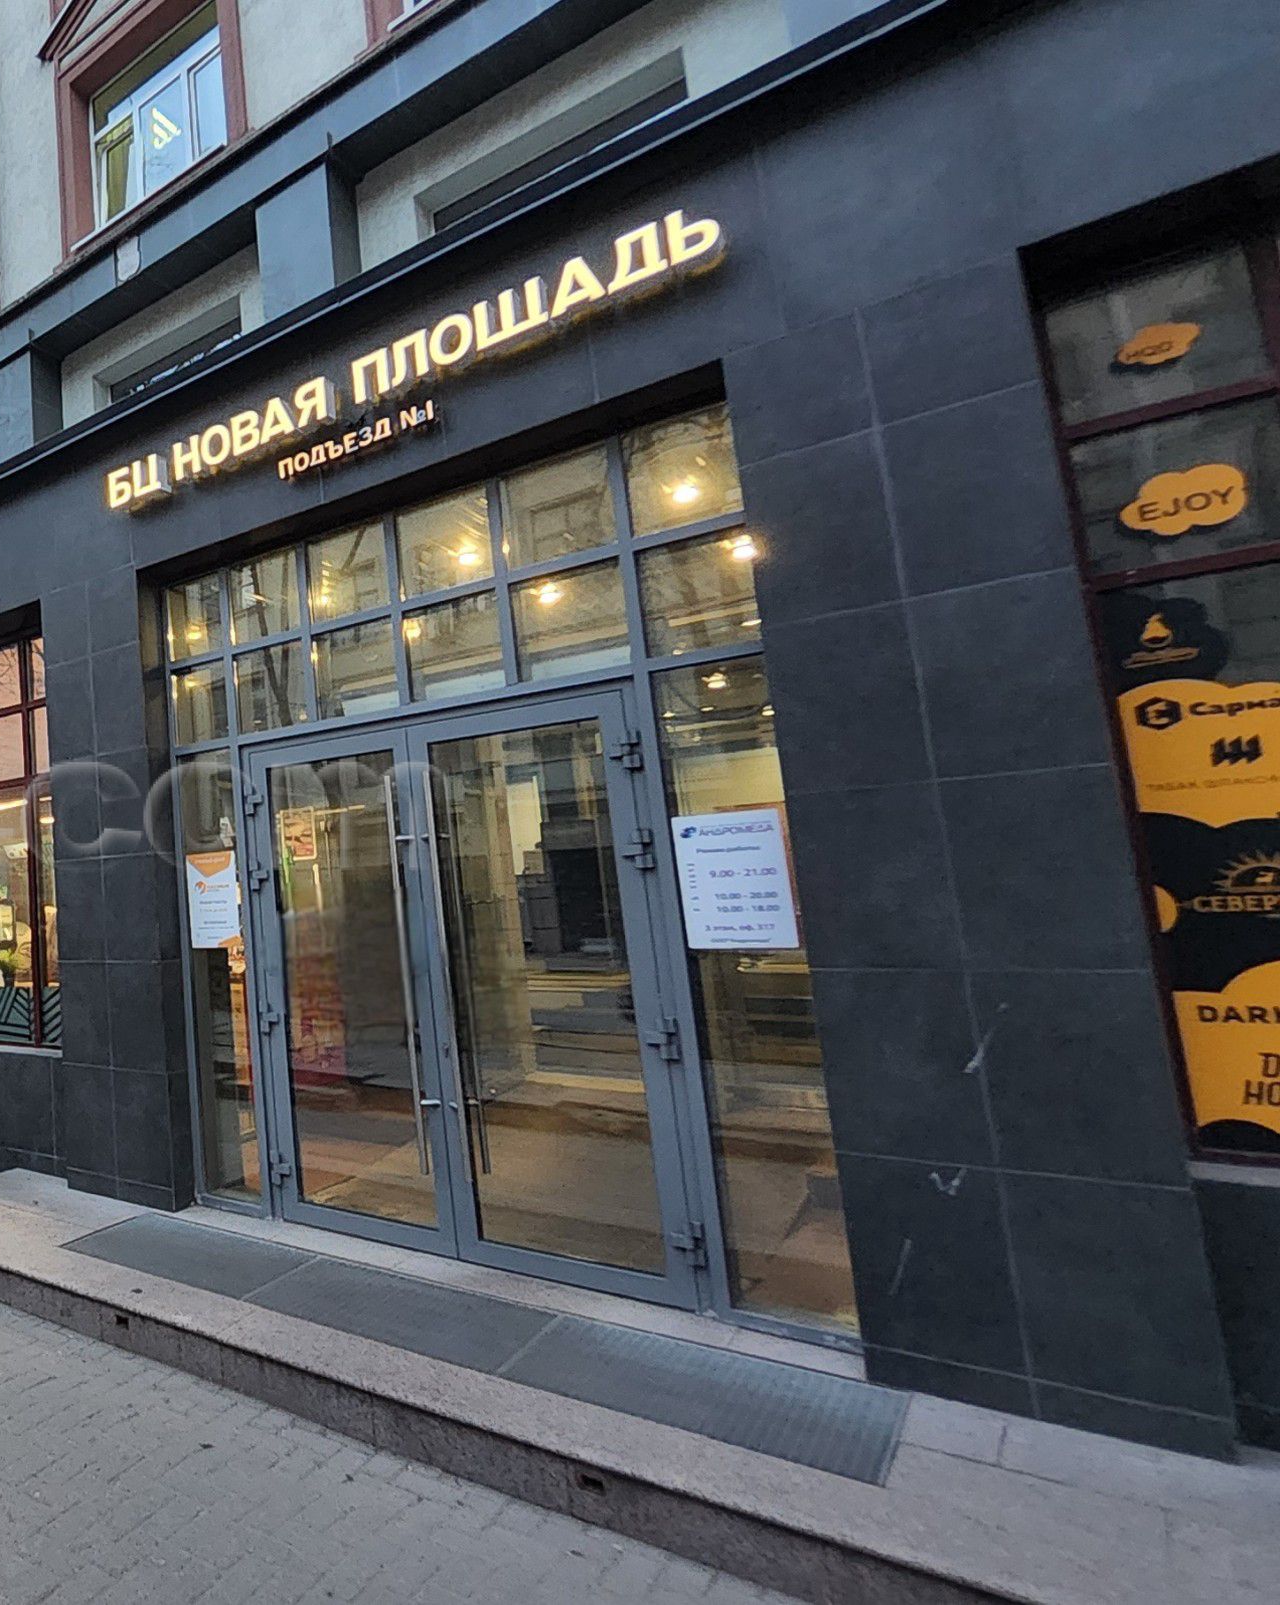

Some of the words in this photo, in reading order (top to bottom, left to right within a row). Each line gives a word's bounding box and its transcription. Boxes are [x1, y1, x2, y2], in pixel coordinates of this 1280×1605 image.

[106, 460, 168, 509] БЦ
[171, 377, 330, 482] НОВАЯ
[351, 209, 722, 404] ПЛОЩАДЬ
[277, 417, 393, 480] ПОДЪЕЗД
[1138, 485, 1236, 522] EJOY
